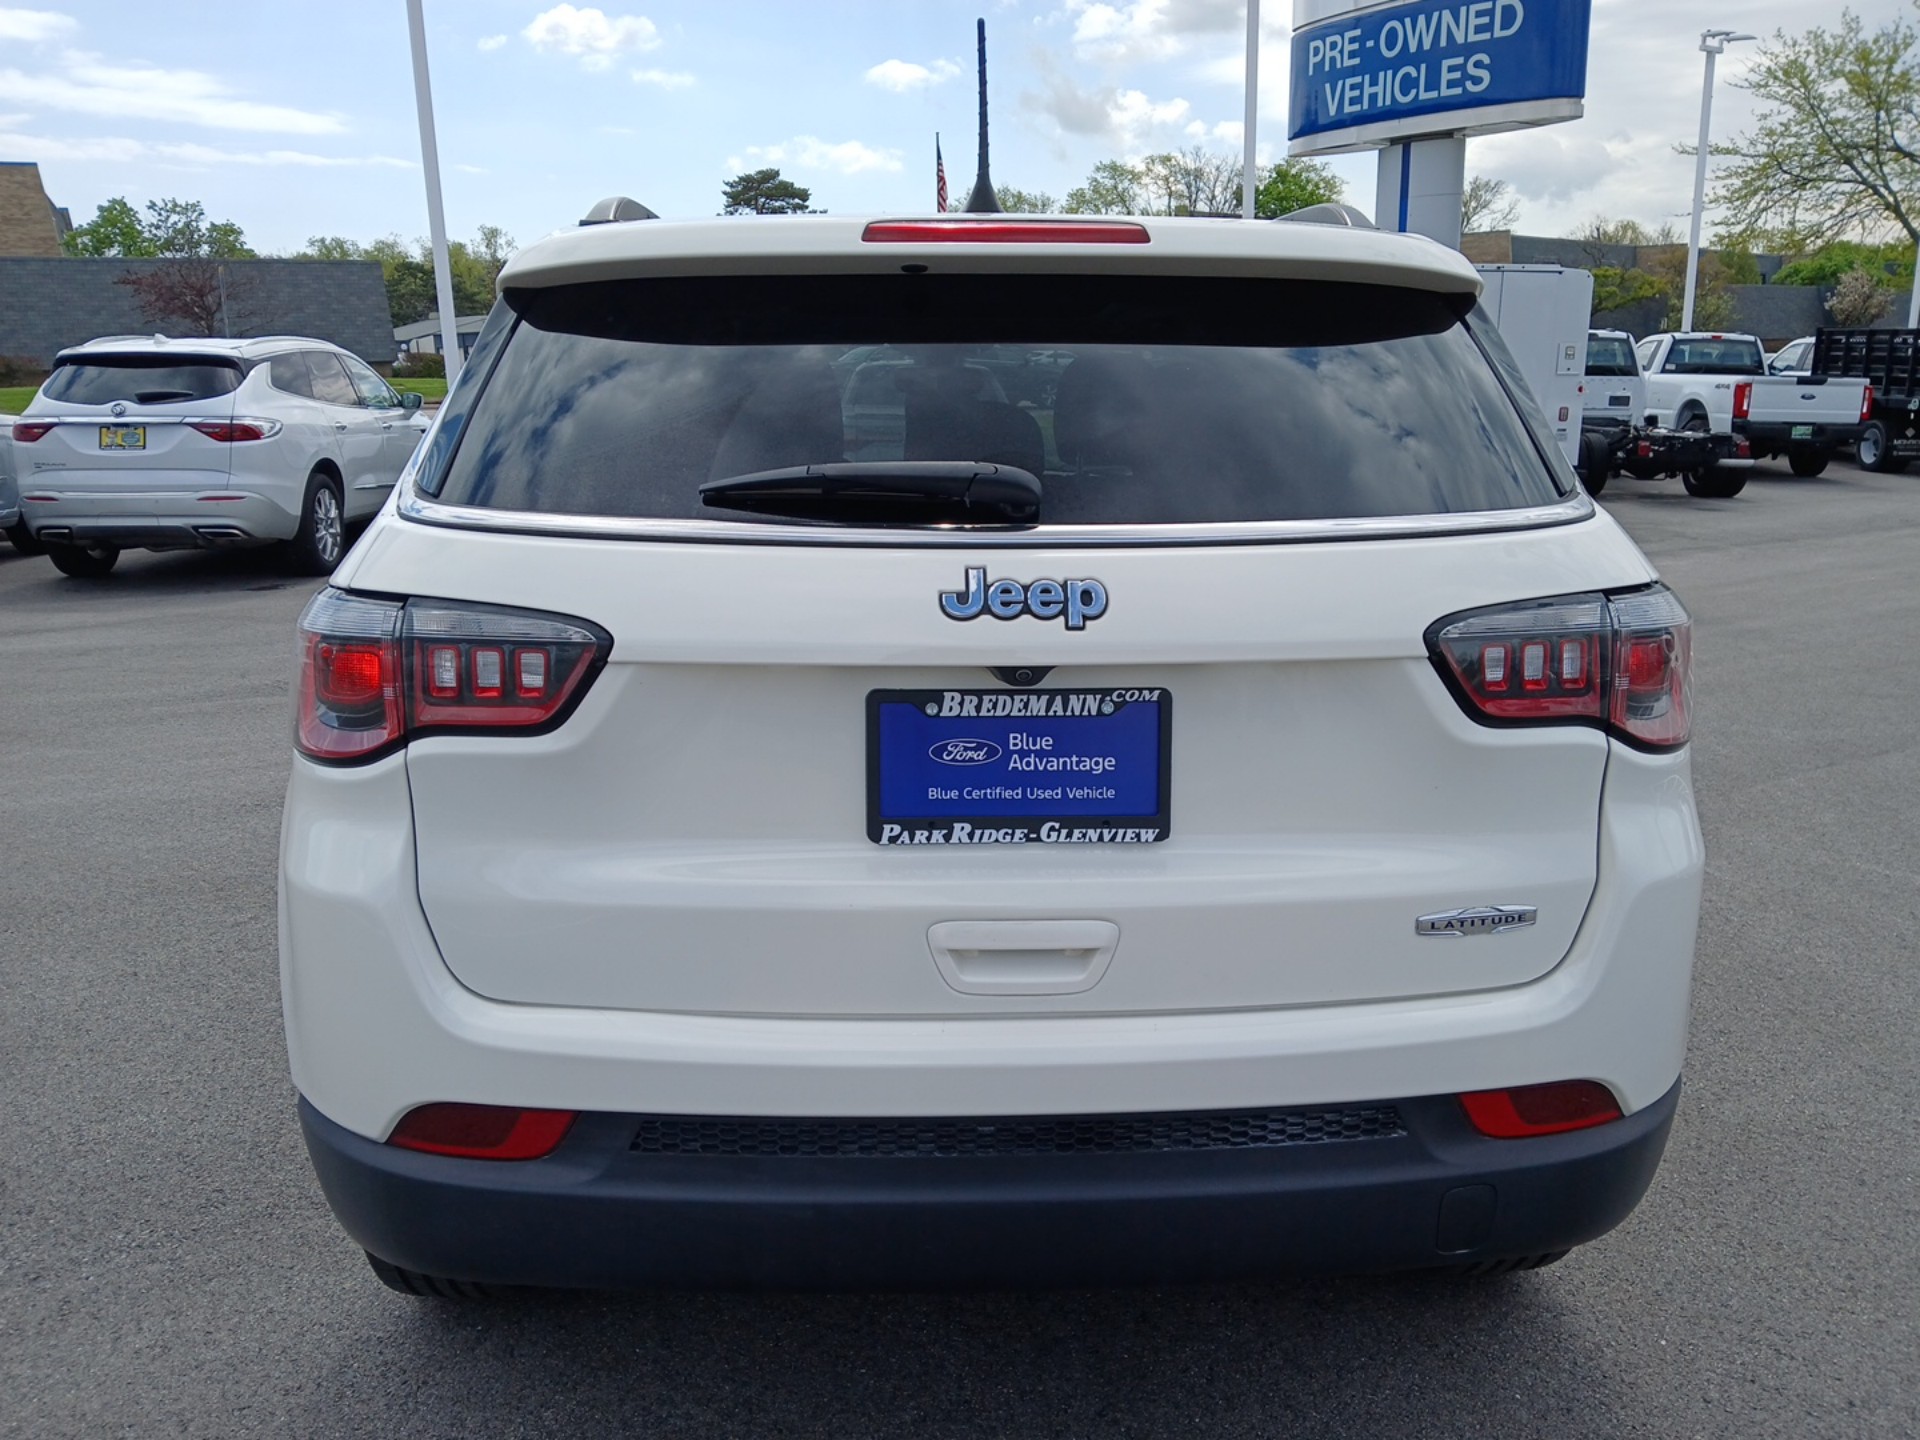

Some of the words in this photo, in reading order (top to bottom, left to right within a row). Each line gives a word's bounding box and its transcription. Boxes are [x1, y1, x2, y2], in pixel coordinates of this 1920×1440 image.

[1324, 53, 1492, 117] VEHICLES
[938, 566, 1108, 631] Jeep
[1008, 733, 1053, 750] Blue
[1008, 753, 1116, 774] Advantage
[928, 787, 959, 799] Blue
[963, 787, 1022, 800] Certified
[1026, 787, 1062, 799] Used
[1066, 787, 1116, 799] Vehicle
[879, 824, 949, 845] PARK
[1430, 913, 1527, 930] LATITUDE
